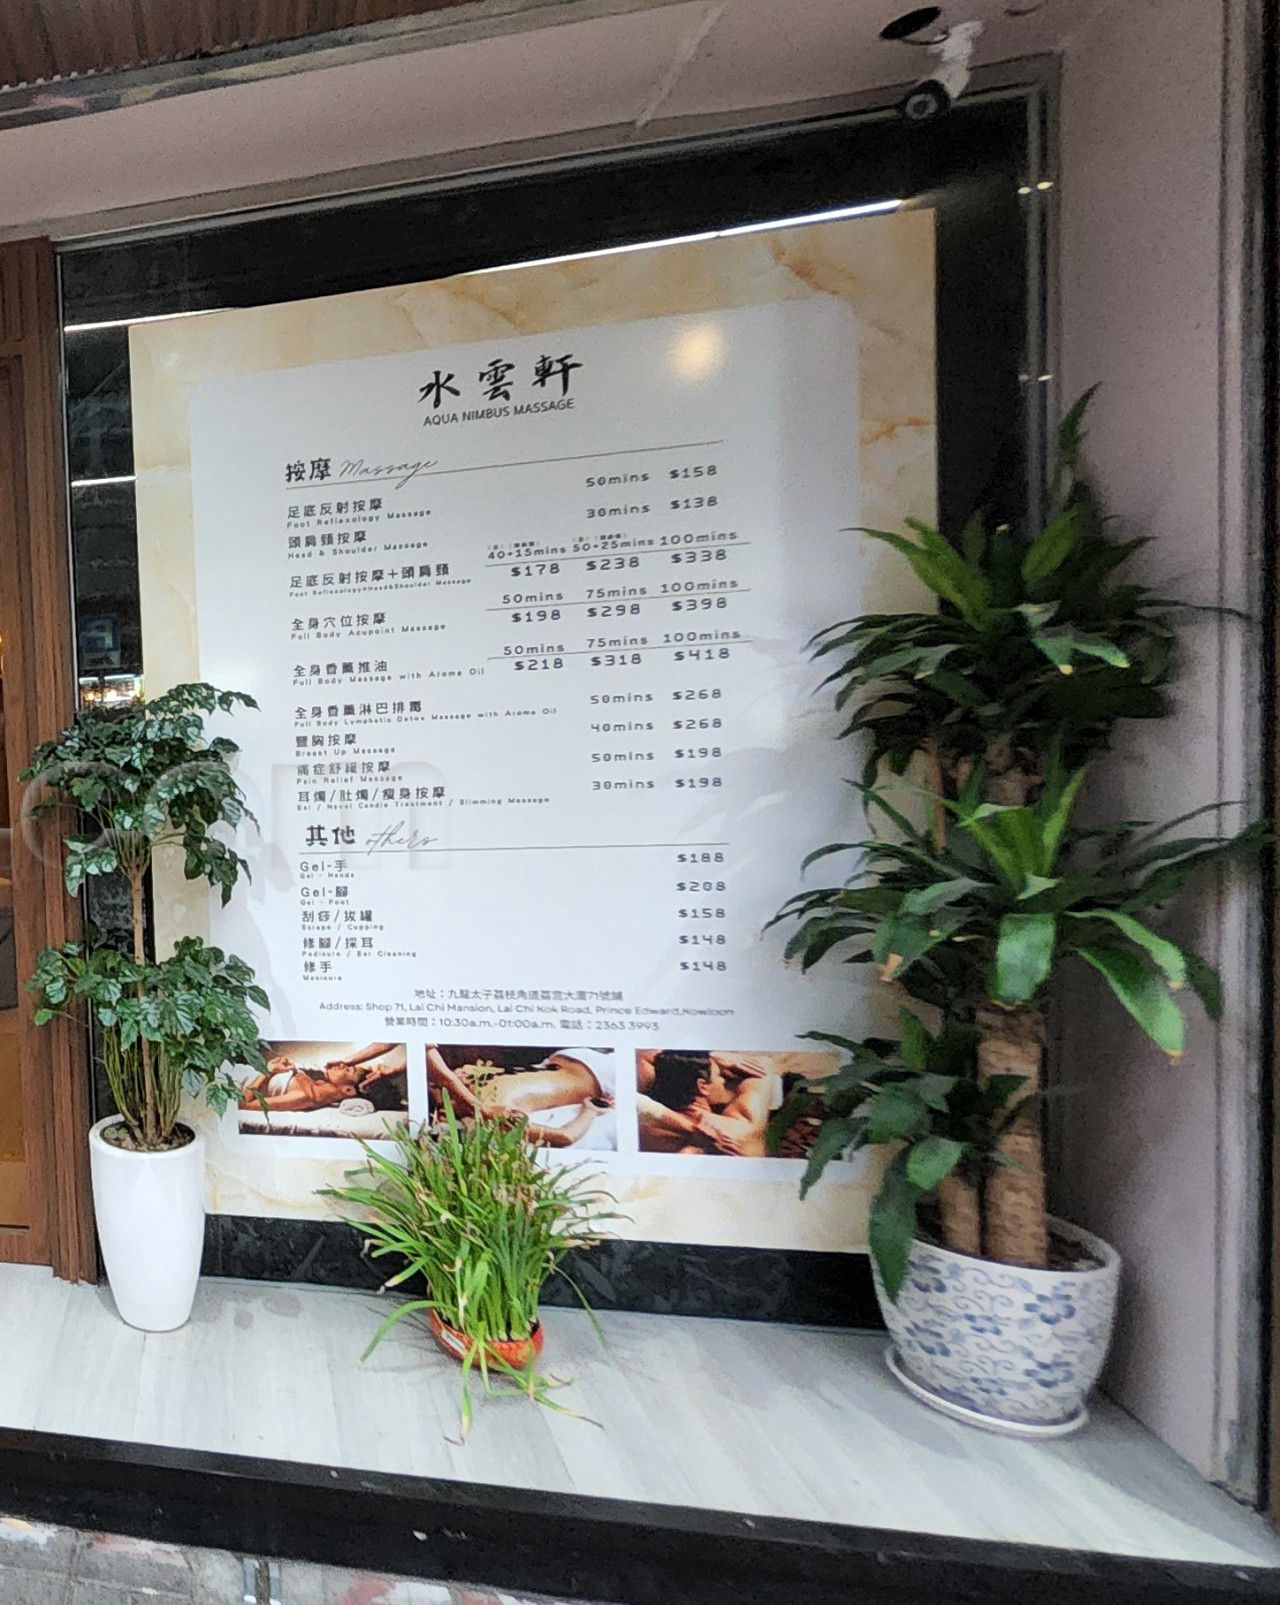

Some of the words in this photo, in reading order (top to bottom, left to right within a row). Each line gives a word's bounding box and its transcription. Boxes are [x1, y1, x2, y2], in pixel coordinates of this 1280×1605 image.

[418, 354, 583, 408] 水雲軒
[422, 413, 459, 427] AQUA
[462, 406, 510, 422] NIMBUS
[514, 398, 576, 416] MASSAGE
[285, 457, 331, 482] 按摩
[586, 473, 649, 487] 50mins
[670, 465, 716, 479] $158
[288, 498, 382, 519] 足底反射按摩
[587, 505, 650, 518] 30mins
[671, 496, 717, 509] $138
[287, 521, 309, 529] Foot
[289, 531, 366, 549] 頭肩頸按摩
[660, 532, 737, 546] 100mins
[332, 546, 377, 555] Shoulder
[511, 563, 559, 577] $178
[586, 557, 639, 570] $238
[671, 549, 726, 563] $338
[503, 592, 563, 604] 50mins
[586, 586, 647, 599] 75mins
[661, 579, 738, 593] 100mins
[512, 610, 560, 622] $198
[588, 604, 640, 617] $298
[672, 597, 726, 611] $398
[292, 612, 385, 631] 全身穴位按摩
[504, 644, 566, 657] 50mins
[587, 636, 648, 648] 75mins
[664, 630, 740, 643] 100mins
[515, 658, 563, 670] $218
[591, 653, 641, 666] $318
[674, 648, 729, 661] $418
[591, 693, 653, 704] 50mins
[673, 689, 721, 700] $268
[591, 722, 653, 732] 40mins
[674, 718, 721, 729] $268
[592, 752, 654, 762] 50mins
[675, 747, 721, 758] $198
[675, 778, 722, 788] $198
[306, 825, 356, 847] 其他
[678, 852, 723, 863] $188
[300, 860, 347, 873] Gel-手
[301, 886, 348, 897] Gel-腳
[676, 882, 725, 891] $208
[679, 908, 725, 918] $158
[679, 935, 725, 944] $148
[304, 961, 333, 973] 修手
[680, 961, 726, 971] $148
[366, 1003, 392, 1012] Shop
[409, 1003, 424, 1011] Lai
[426, 1003, 444, 1011] Chi
